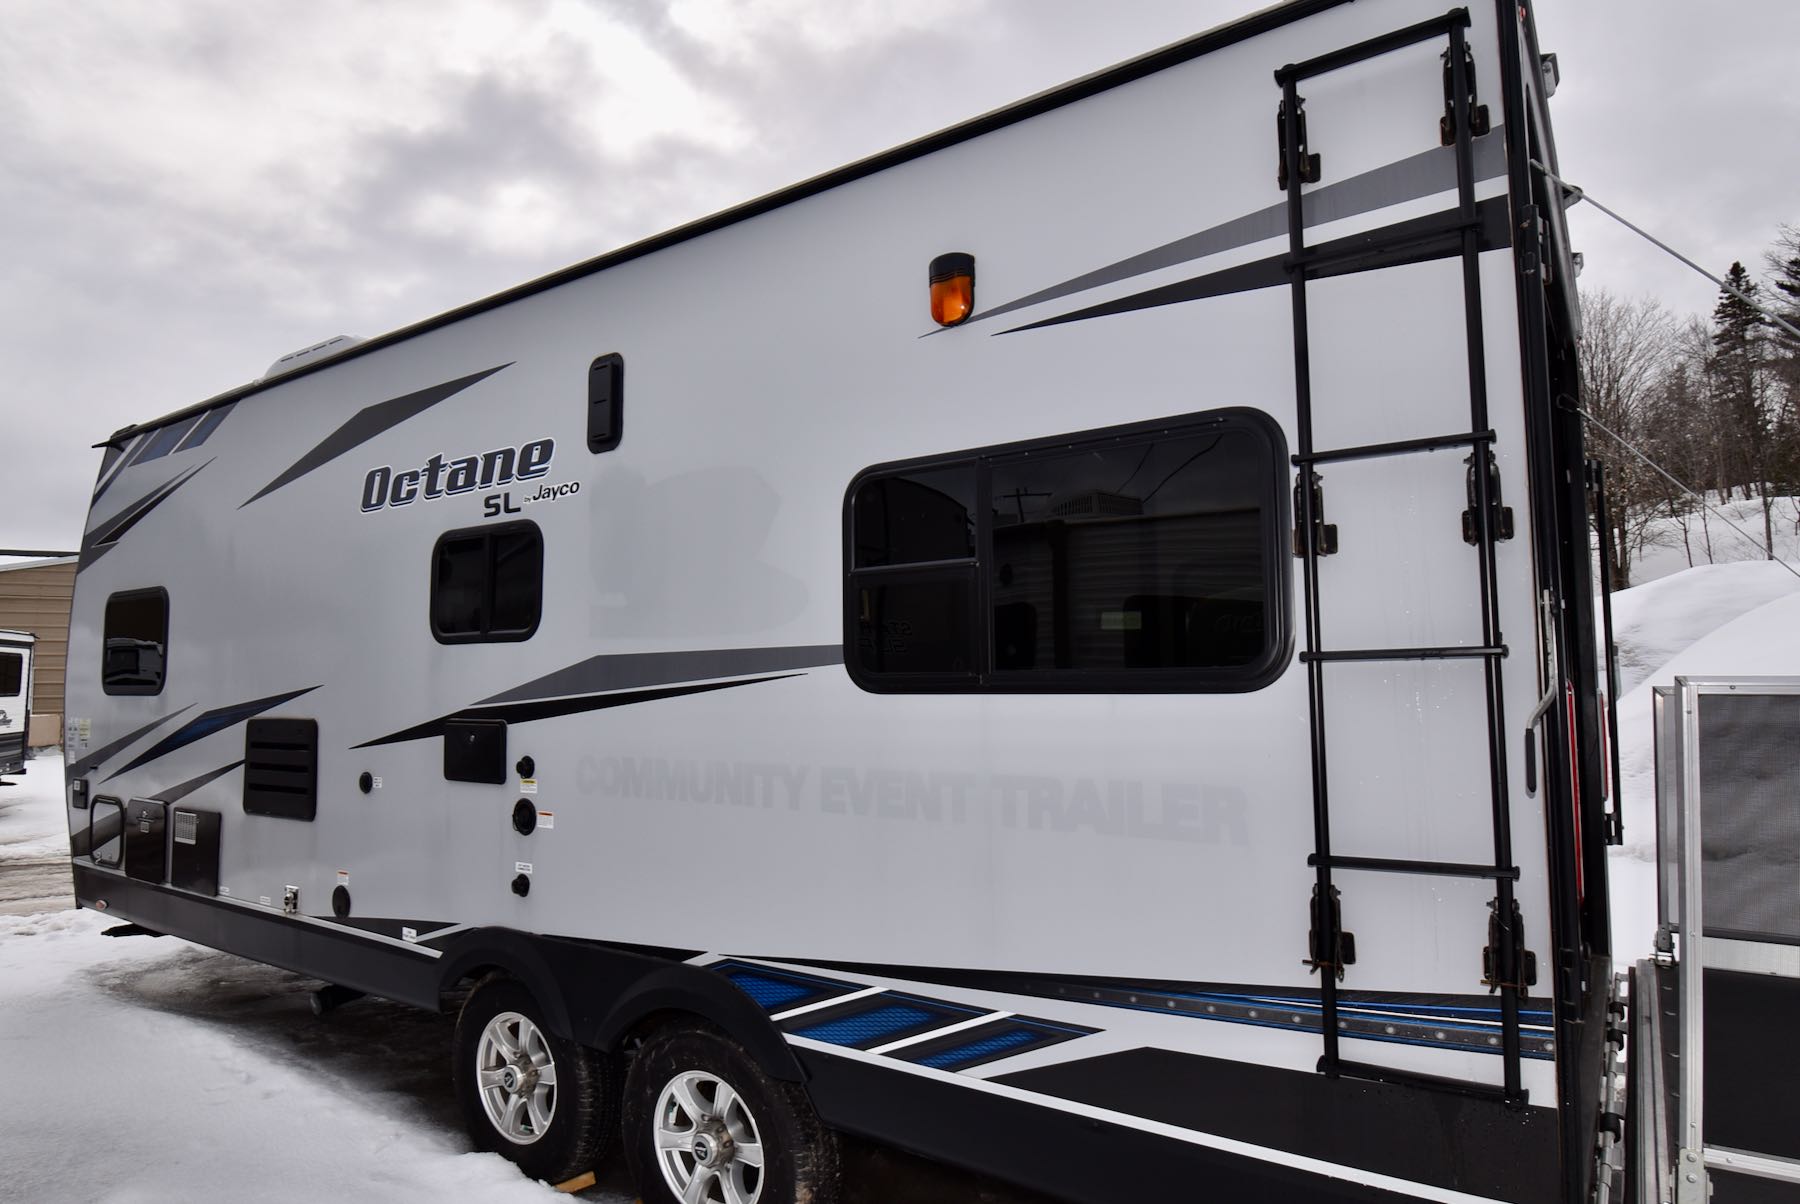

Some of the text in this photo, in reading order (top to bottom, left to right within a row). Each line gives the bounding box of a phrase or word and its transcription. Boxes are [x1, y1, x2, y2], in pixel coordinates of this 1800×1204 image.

[360, 437, 556, 514] Octane
[484, 492, 521, 518] SL
[533, 482, 580, 501] Jayco
[575, 755, 1250, 847] COMMUNITY EVENT TRAILER
